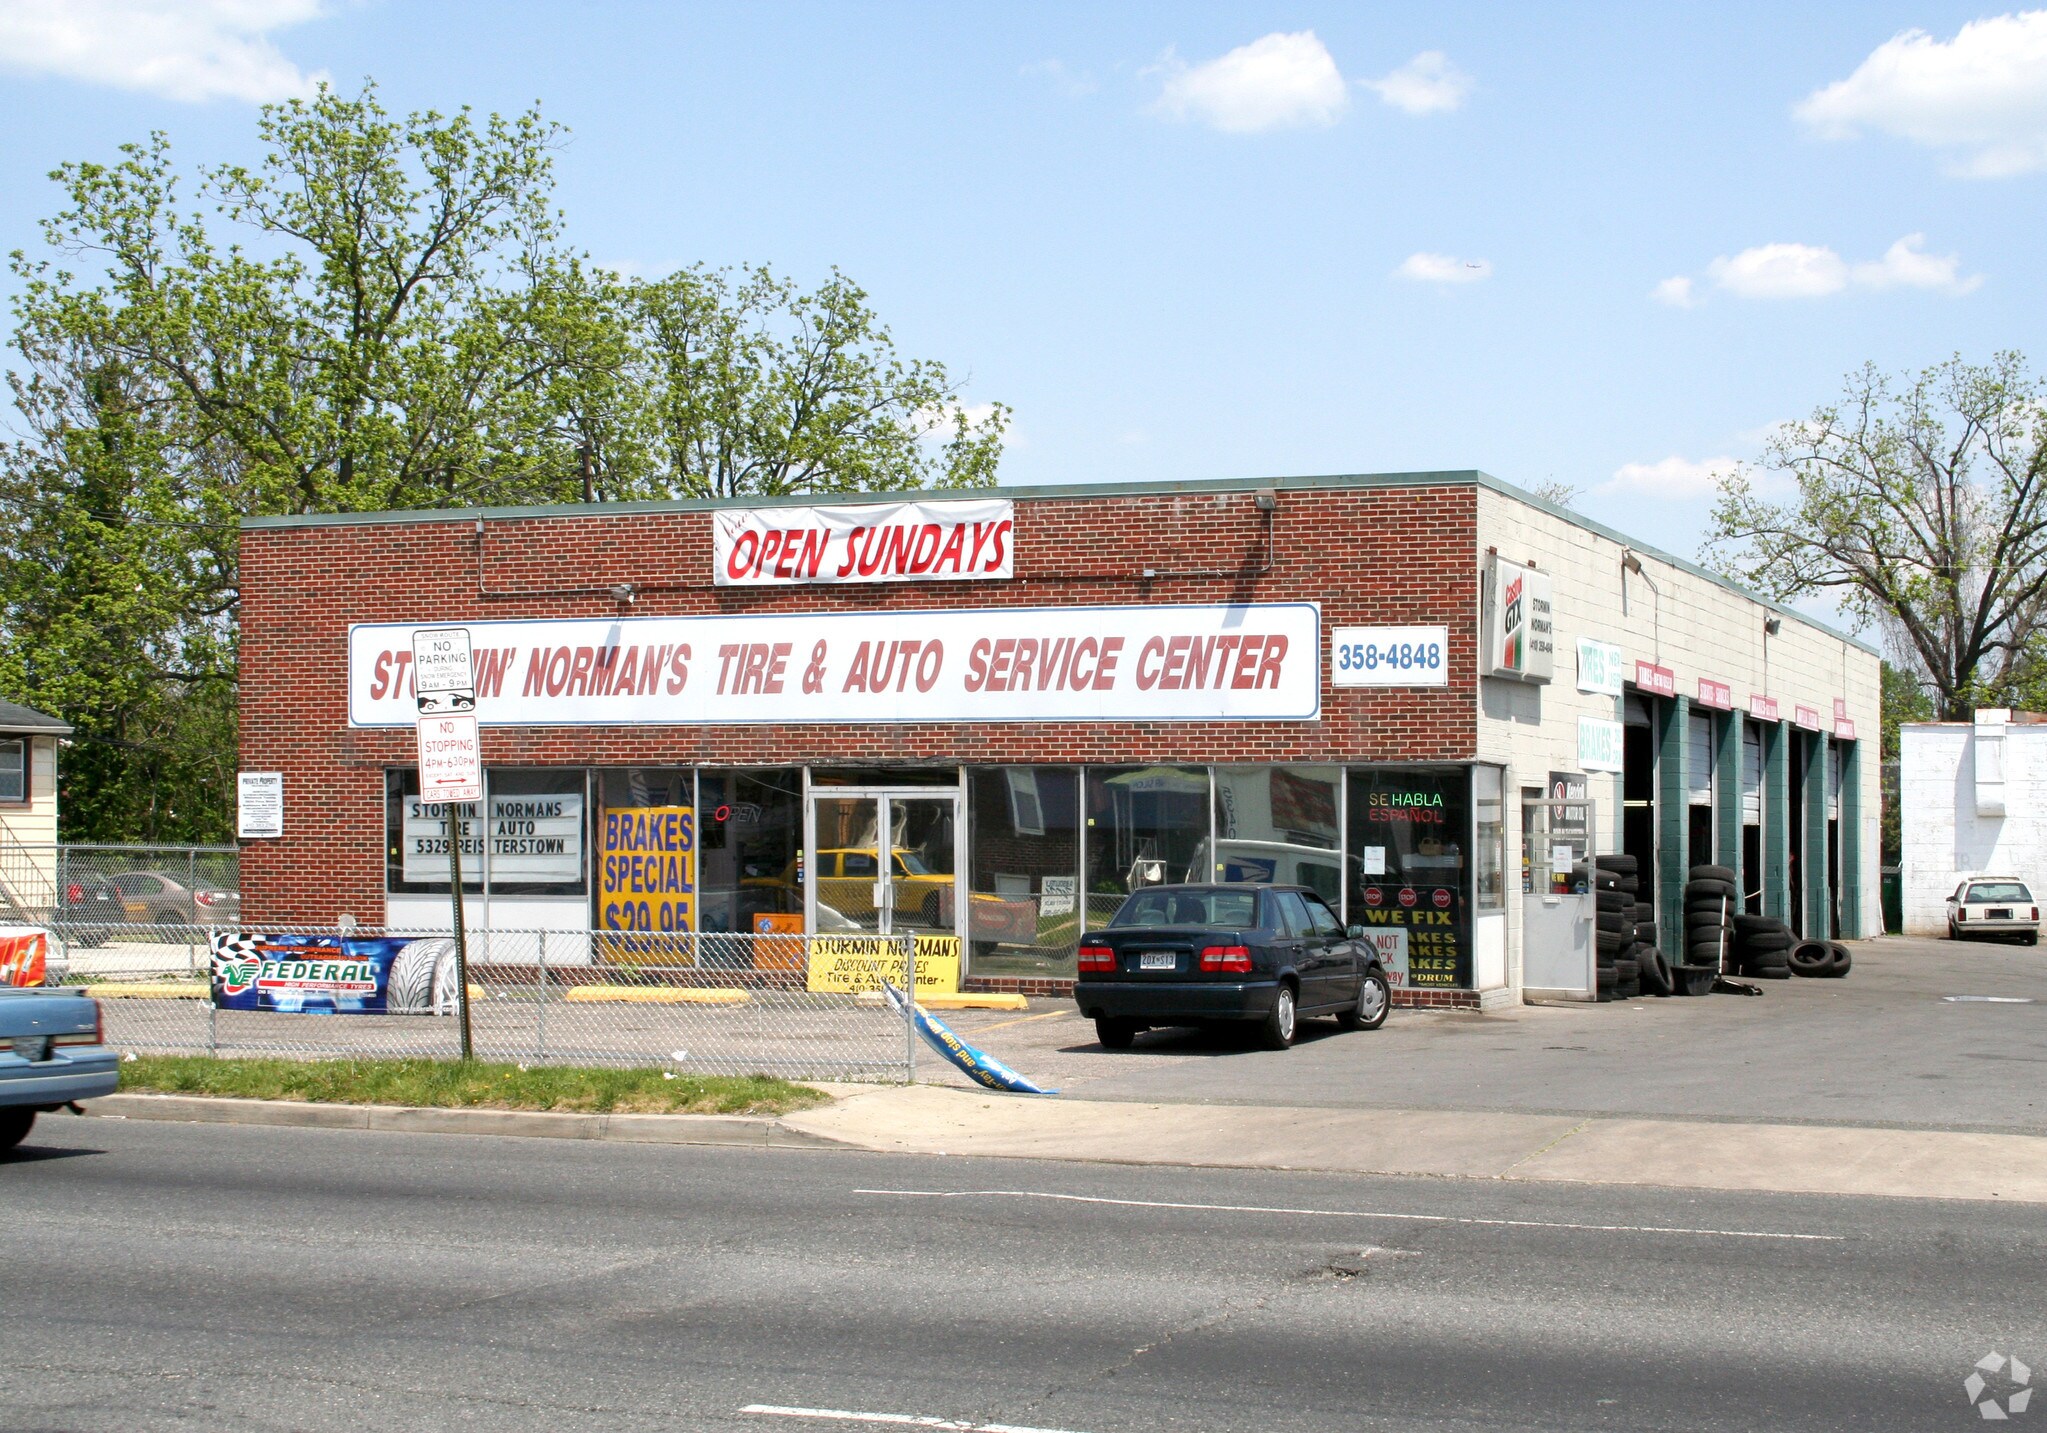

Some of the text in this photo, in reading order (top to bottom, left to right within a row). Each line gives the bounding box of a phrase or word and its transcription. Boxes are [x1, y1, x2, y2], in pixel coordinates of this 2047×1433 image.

[727, 520, 1012, 579] OPEN SUNDAYS
[1505, 595, 1522, 634] GTX
[433, 641, 451, 652] NO
[419, 653, 467, 664] PARKING
[1338, 642, 1441, 670] 358-4848
[370, 634, 1289, 700] STIN' NORMAN'S TIRE & AUTO SERVICE CENTER
[440, 722, 454, 734] NO
[425, 740, 474, 753] STOPPING
[1579, 723, 1611, 762] BRAKES
[427, 788, 477, 799] CARS TOWED AWAY
[1369, 793, 1443, 807] SE HABLA
[496, 802, 562, 817] NORMANS
[714, 805, 762, 823] OPEN
[1369, 807, 1444, 823] ESPAÑOL
[498, 821, 535, 835] AUTO
[605, 813, 693, 852] BRAKES
[416, 839, 449, 854] 5329
[604, 855, 693, 894] SPECIAL
[1365, 909, 1452, 925] WE FIX
[1376, 935, 1399, 949] NOT
[260, 962, 373, 981] FEDERAL
[827, 972, 849, 983] Tire
[854, 973, 863, 983] &
[1417, 973, 1454, 982] DRUM
[941, 1032, 962, 1051] stop
[956, 1049, 976, 1067] and
